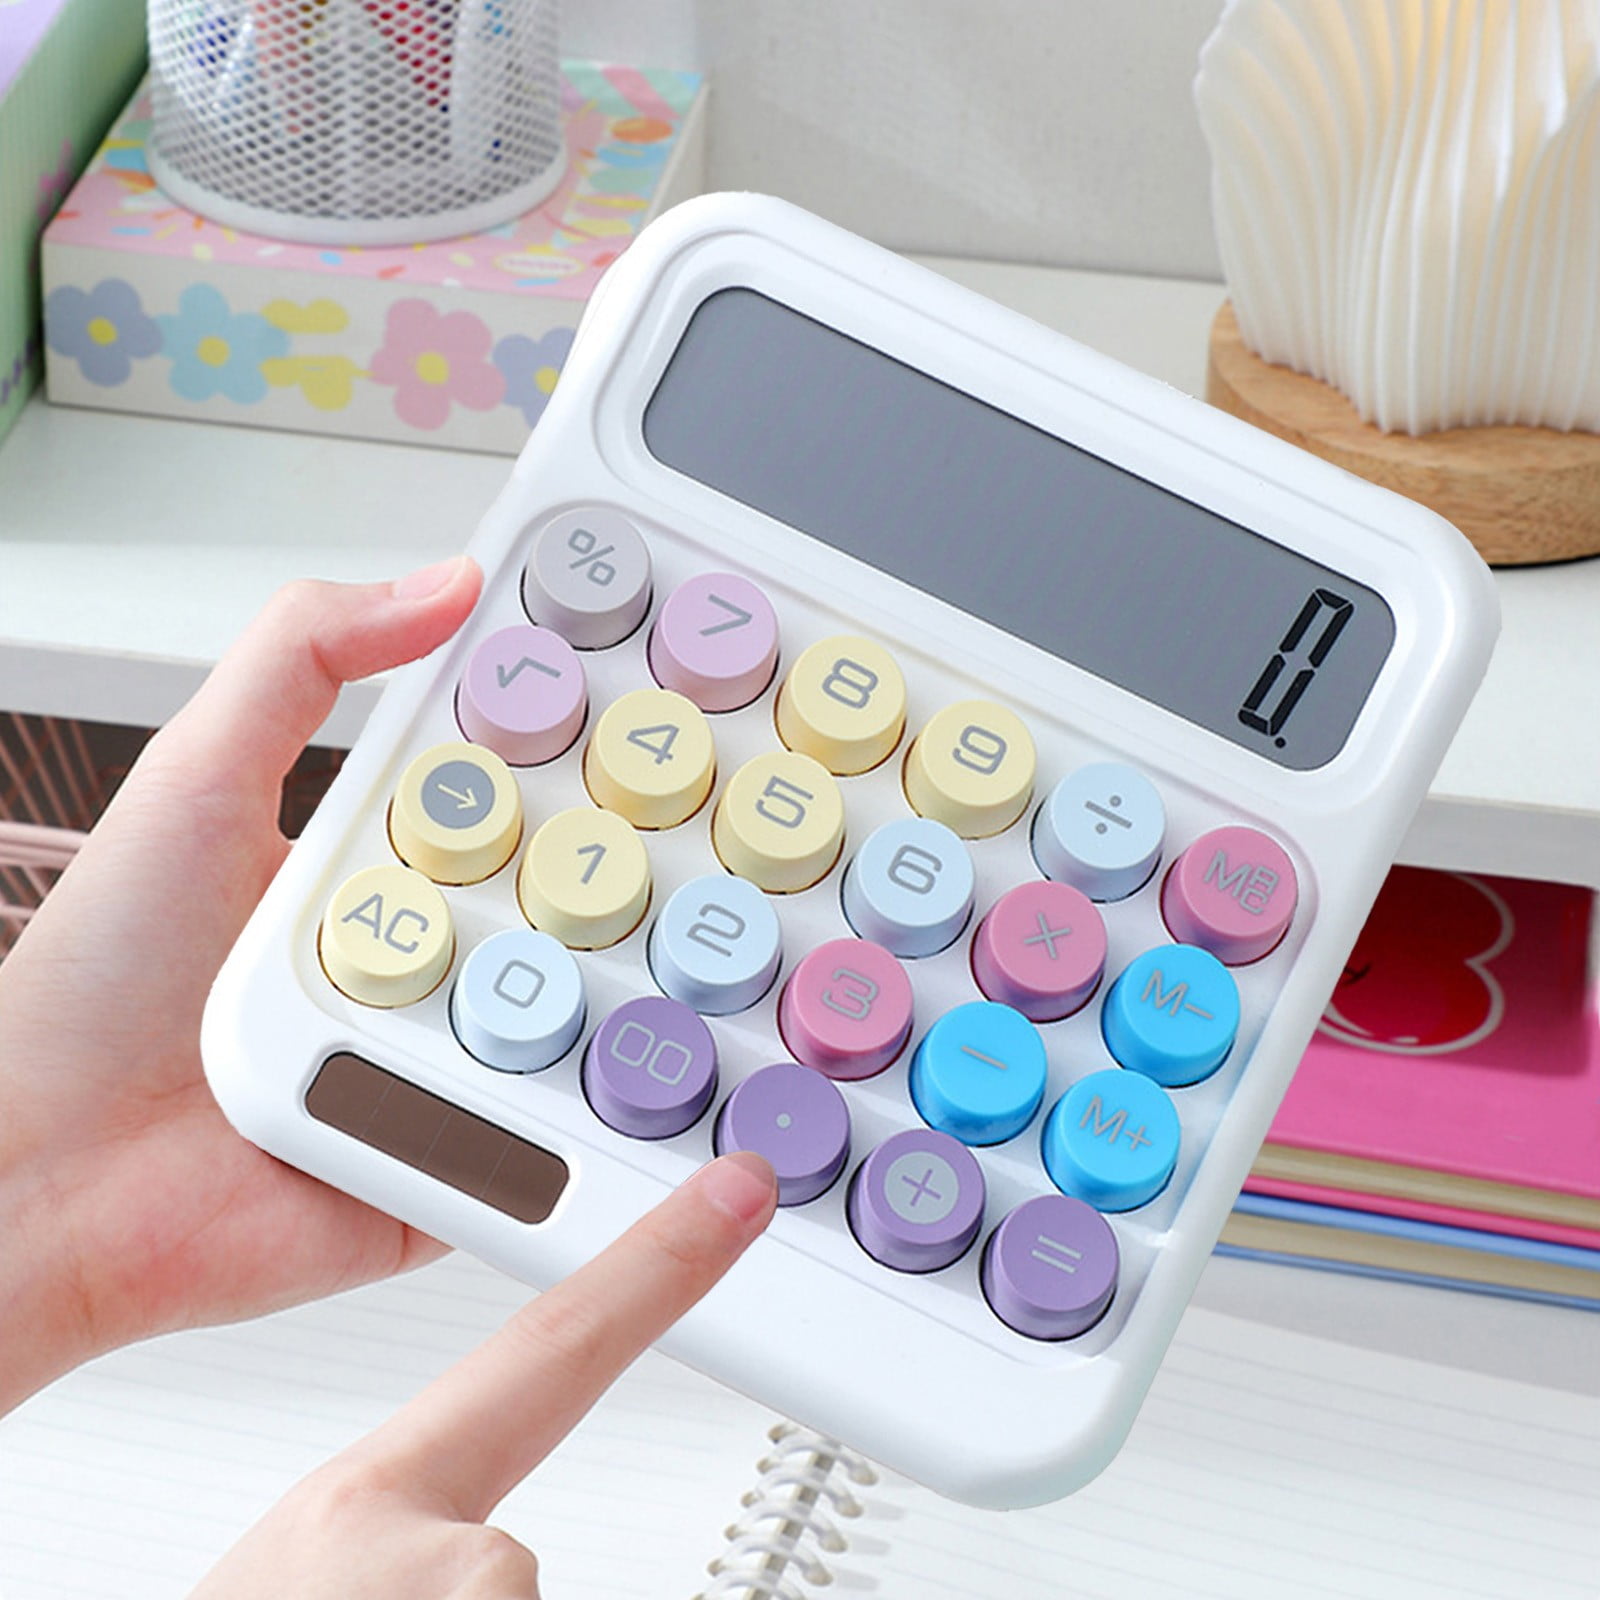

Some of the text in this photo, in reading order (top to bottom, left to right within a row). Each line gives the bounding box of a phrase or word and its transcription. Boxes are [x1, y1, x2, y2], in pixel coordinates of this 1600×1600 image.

[699, 593, 753, 638] 7
[821, 657, 878, 710] 8
[626, 723, 679, 765] 4
[951, 724, 1008, 775] 9
[755, 776, 814, 829] 5
[576, 843, 607, 884] 1
[887, 843, 941, 895] 6
[341, 893, 429, 954] AC
[687, 904, 745, 958] 2
[493, 959, 545, 1009] 0
[822, 968, 878, 1020] 3
[610, 1021, 693, 1086] 00
[1079, 1095, 1152, 1151] M+
